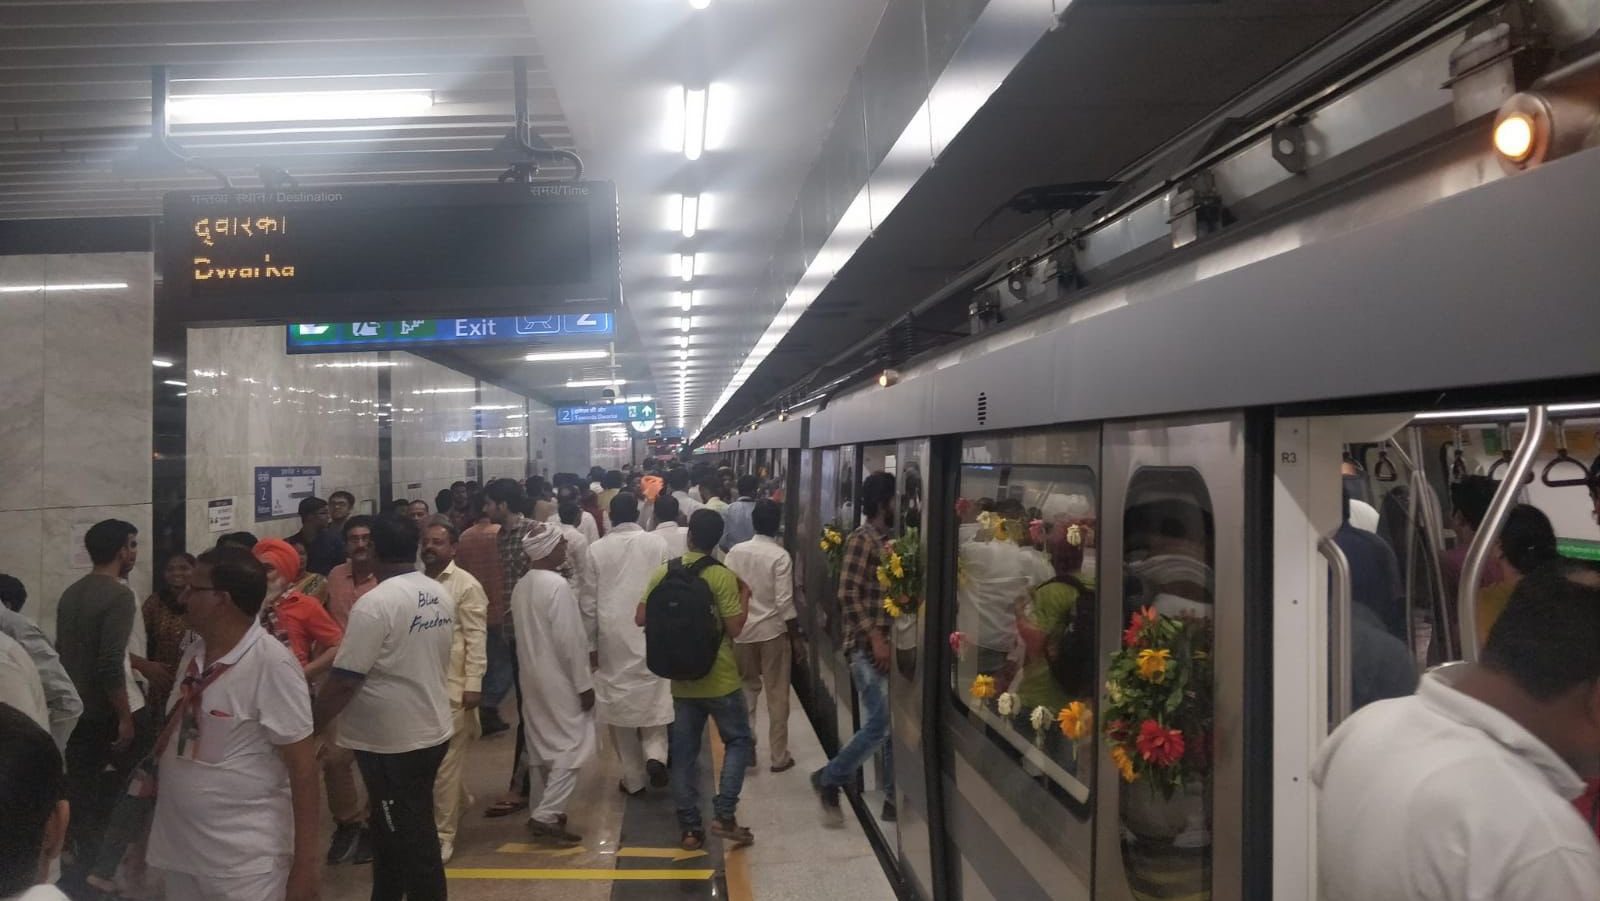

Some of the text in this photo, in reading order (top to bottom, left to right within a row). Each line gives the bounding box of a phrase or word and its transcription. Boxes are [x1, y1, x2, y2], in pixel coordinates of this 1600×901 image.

[276, 192, 343, 202] Destination
[194, 254, 295, 280] Dwarka
[455, 319, 497, 337] Exit
[562, 410, 570, 420] 2
[1281, 451, 1297, 464] R3
[418, 591, 439, 608] Blue
[409, 611, 453, 635] Freedom
